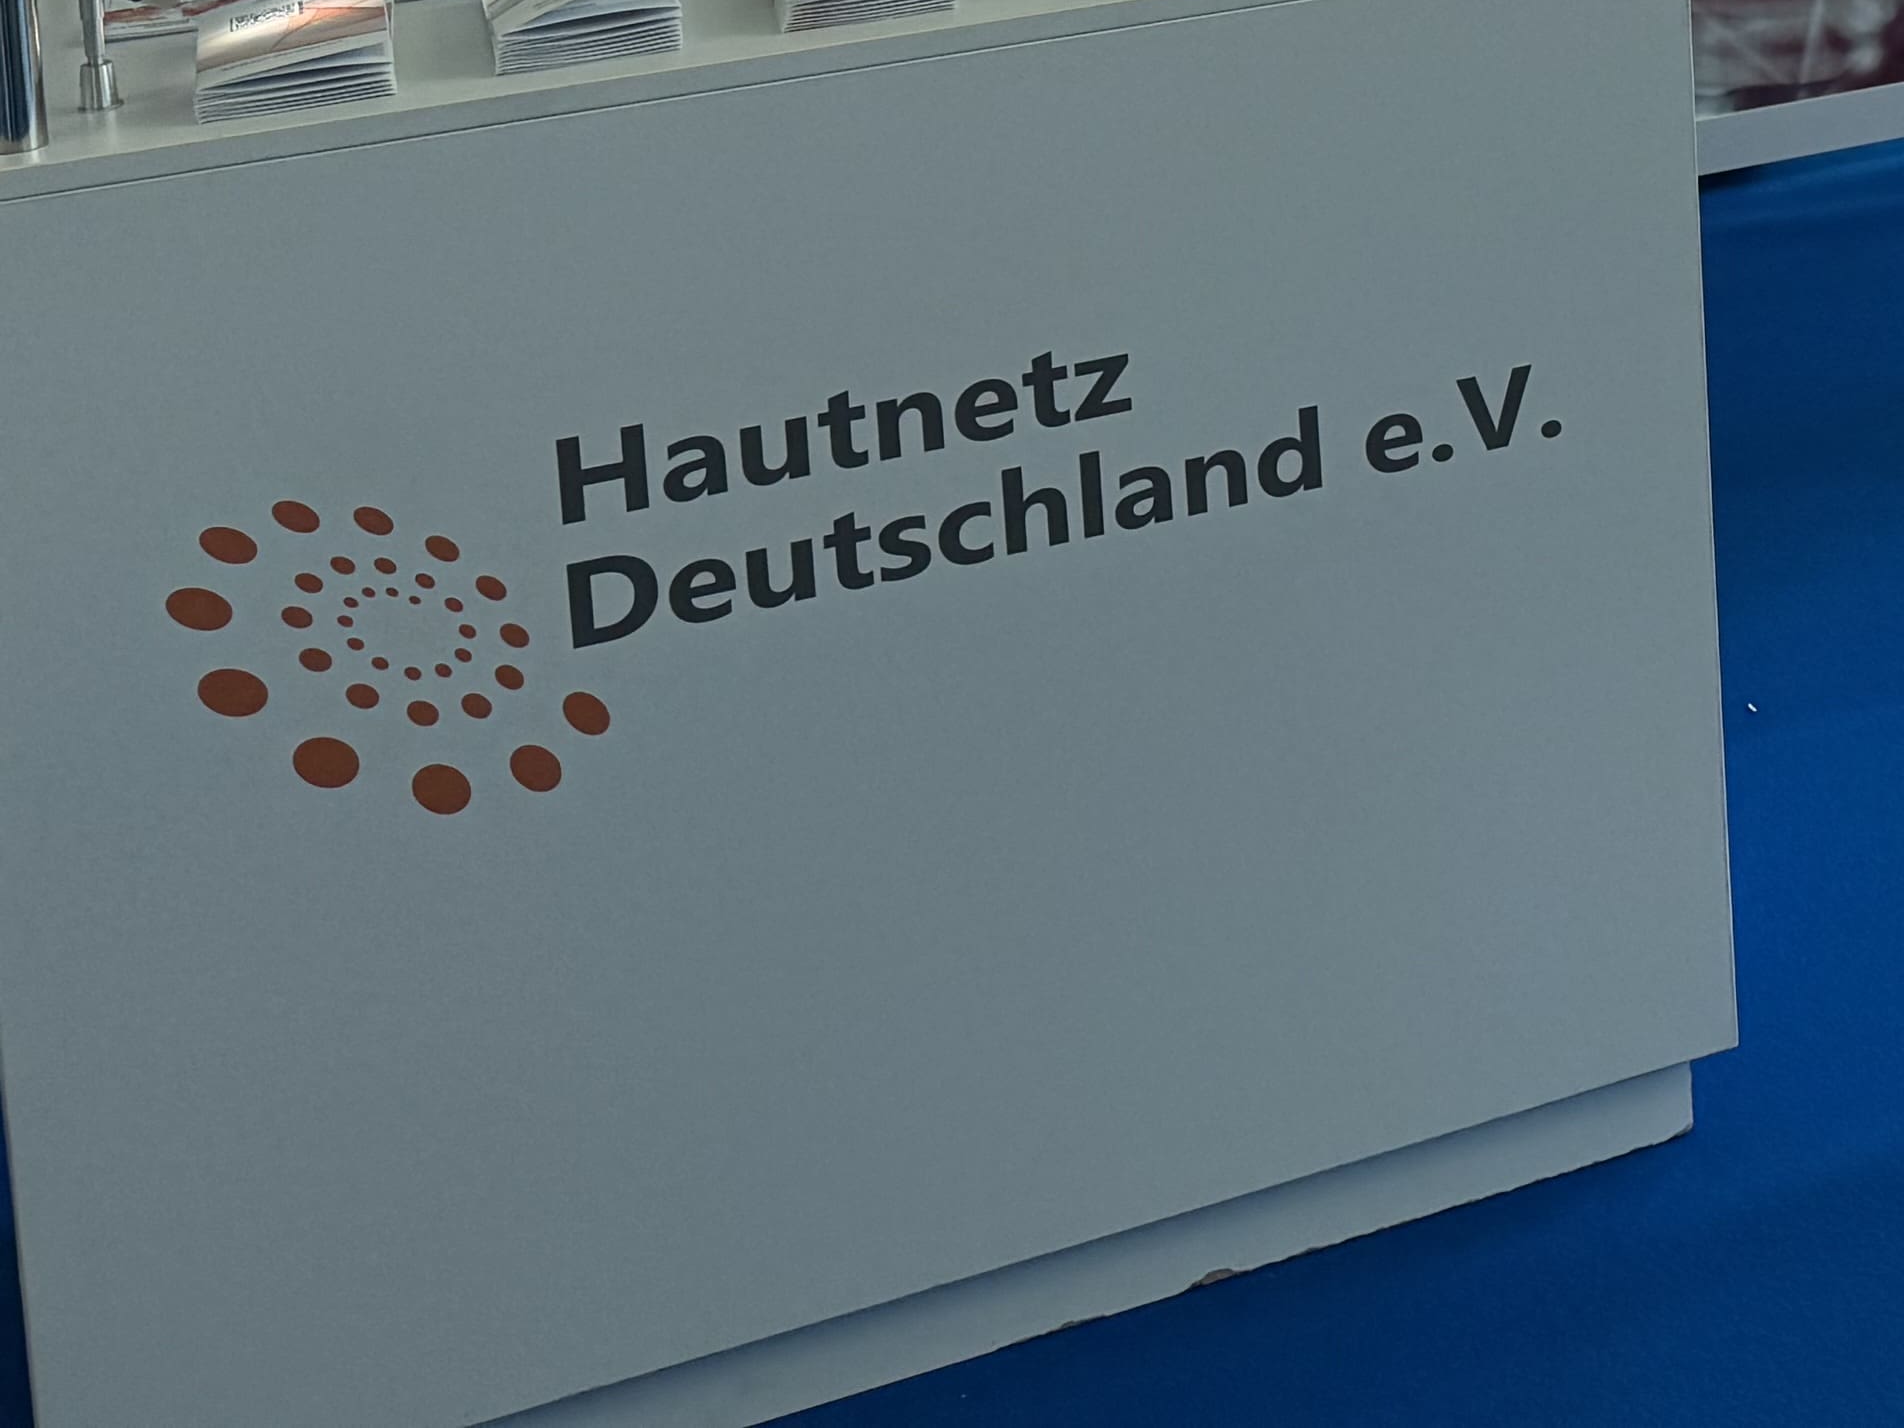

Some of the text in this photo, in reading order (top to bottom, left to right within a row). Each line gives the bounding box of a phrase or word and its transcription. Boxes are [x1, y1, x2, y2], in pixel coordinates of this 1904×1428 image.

[555, 352, 1132, 525] Hautnetz
[564, 363, 1562, 649] Deutschland e.V.
